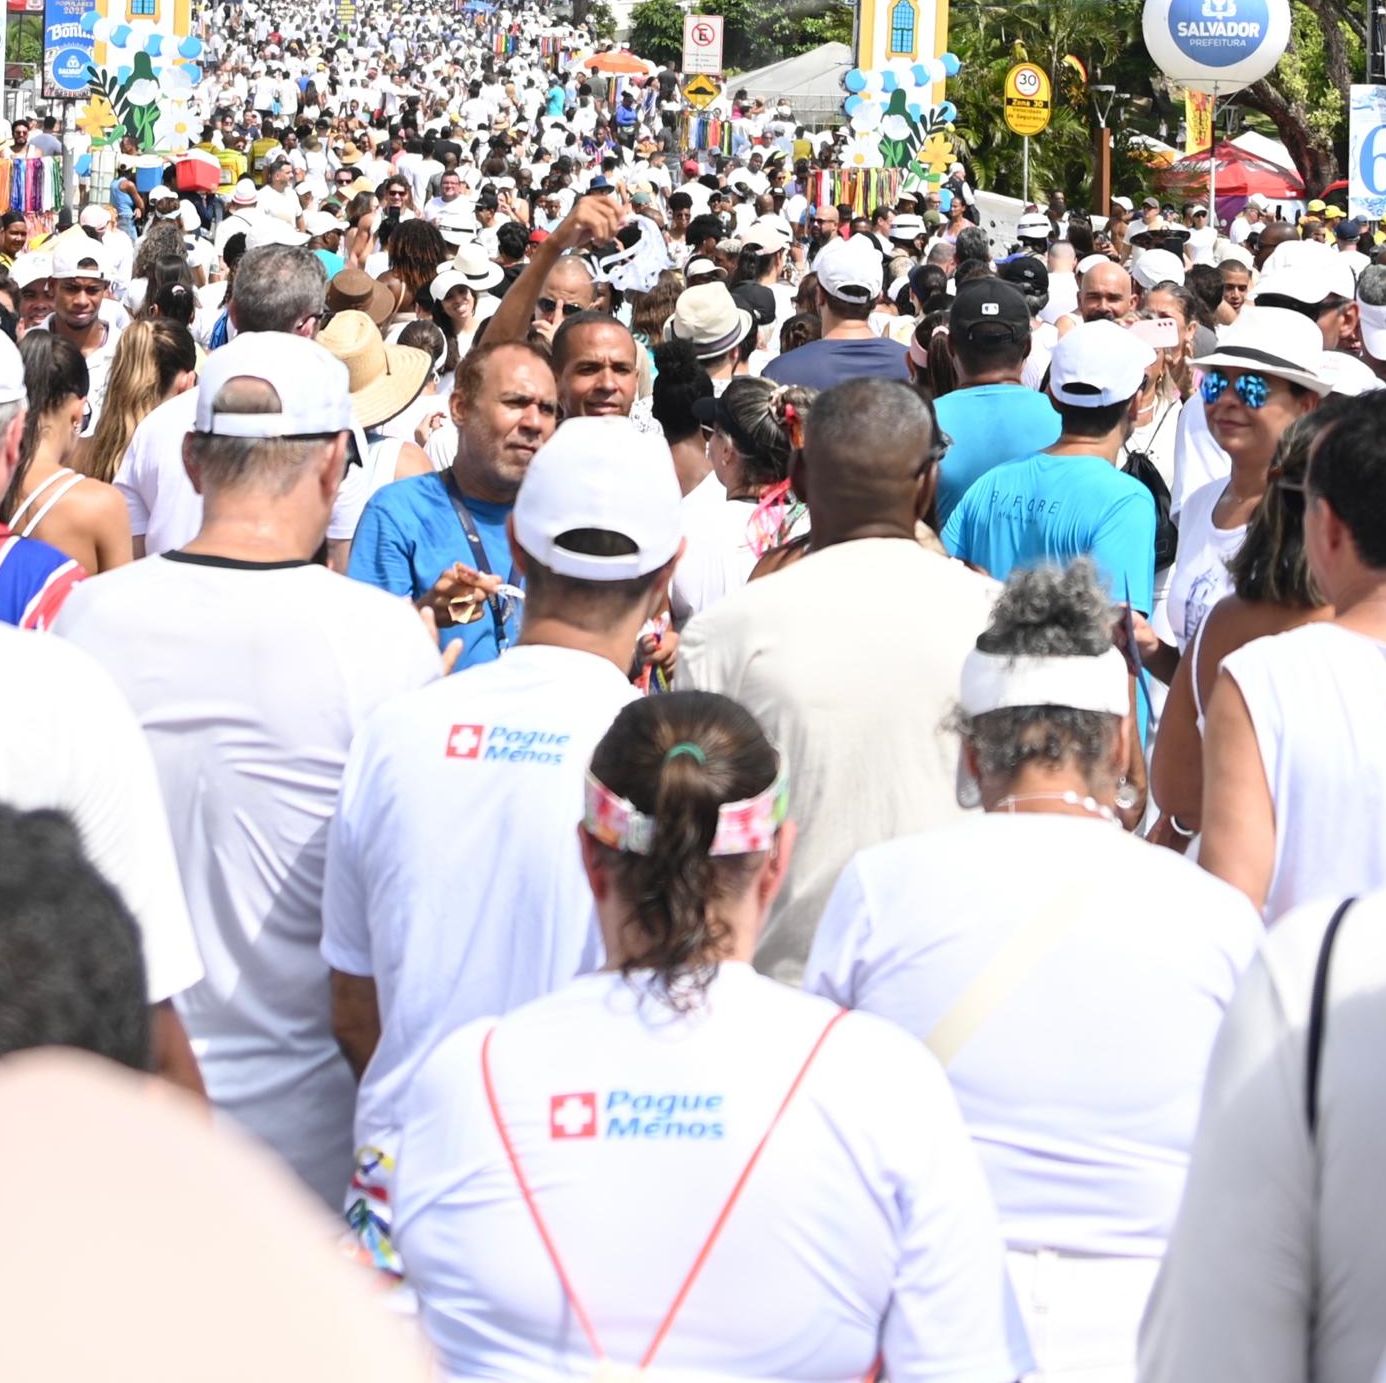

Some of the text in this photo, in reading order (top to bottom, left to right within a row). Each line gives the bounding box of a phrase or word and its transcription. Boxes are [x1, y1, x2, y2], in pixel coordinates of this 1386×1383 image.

[1177, 21, 1260, 37] SALVADOR
[1189, 38, 1246, 47] PREFEITURA
[1019, 73, 1036, 86] 30
[486, 725, 571, 753] Pague
[482, 743, 564, 767] Menos
[605, 1090, 724, 1120] Pague
[605, 1113, 725, 1140] Menos
